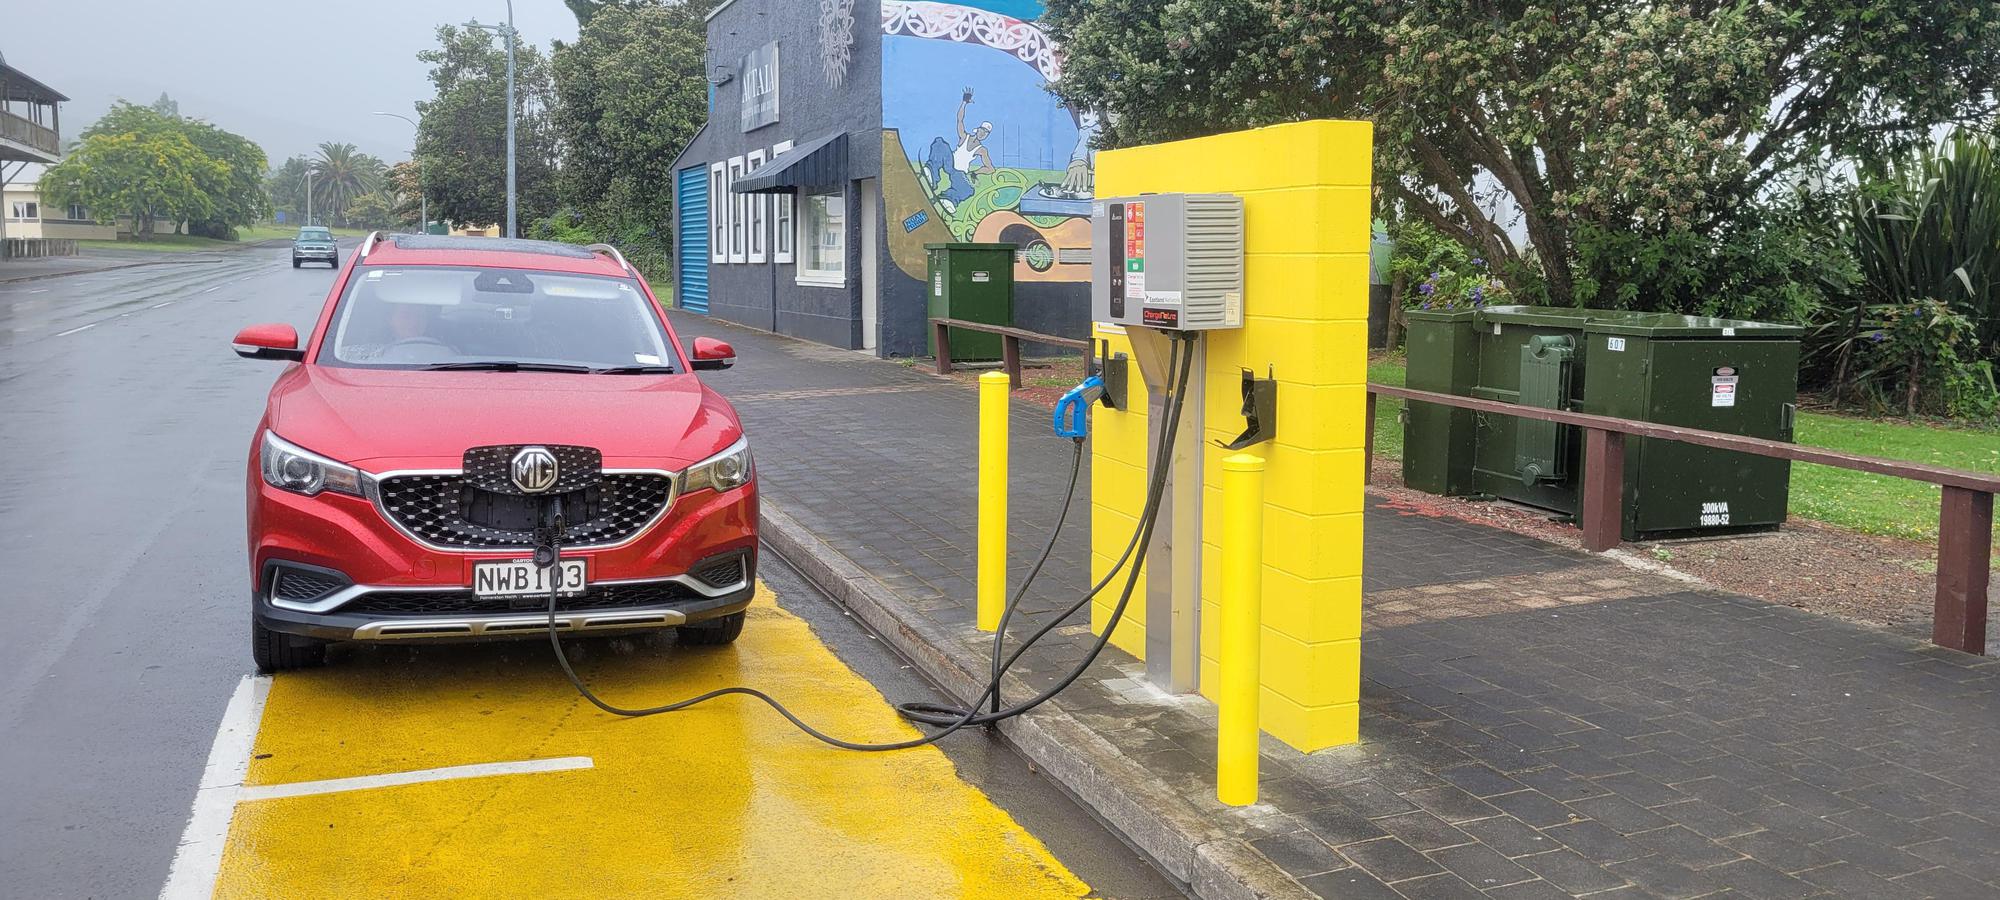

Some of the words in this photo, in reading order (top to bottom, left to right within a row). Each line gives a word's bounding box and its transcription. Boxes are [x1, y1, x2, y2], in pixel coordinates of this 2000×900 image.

[1609, 339, 1624, 350] 607
[517, 453, 553, 488] MG
[1702, 502, 1728, 513] 300kVA
[1700, 514, 1729, 525] 19880-52
[478, 565, 582, 591] NWB103
